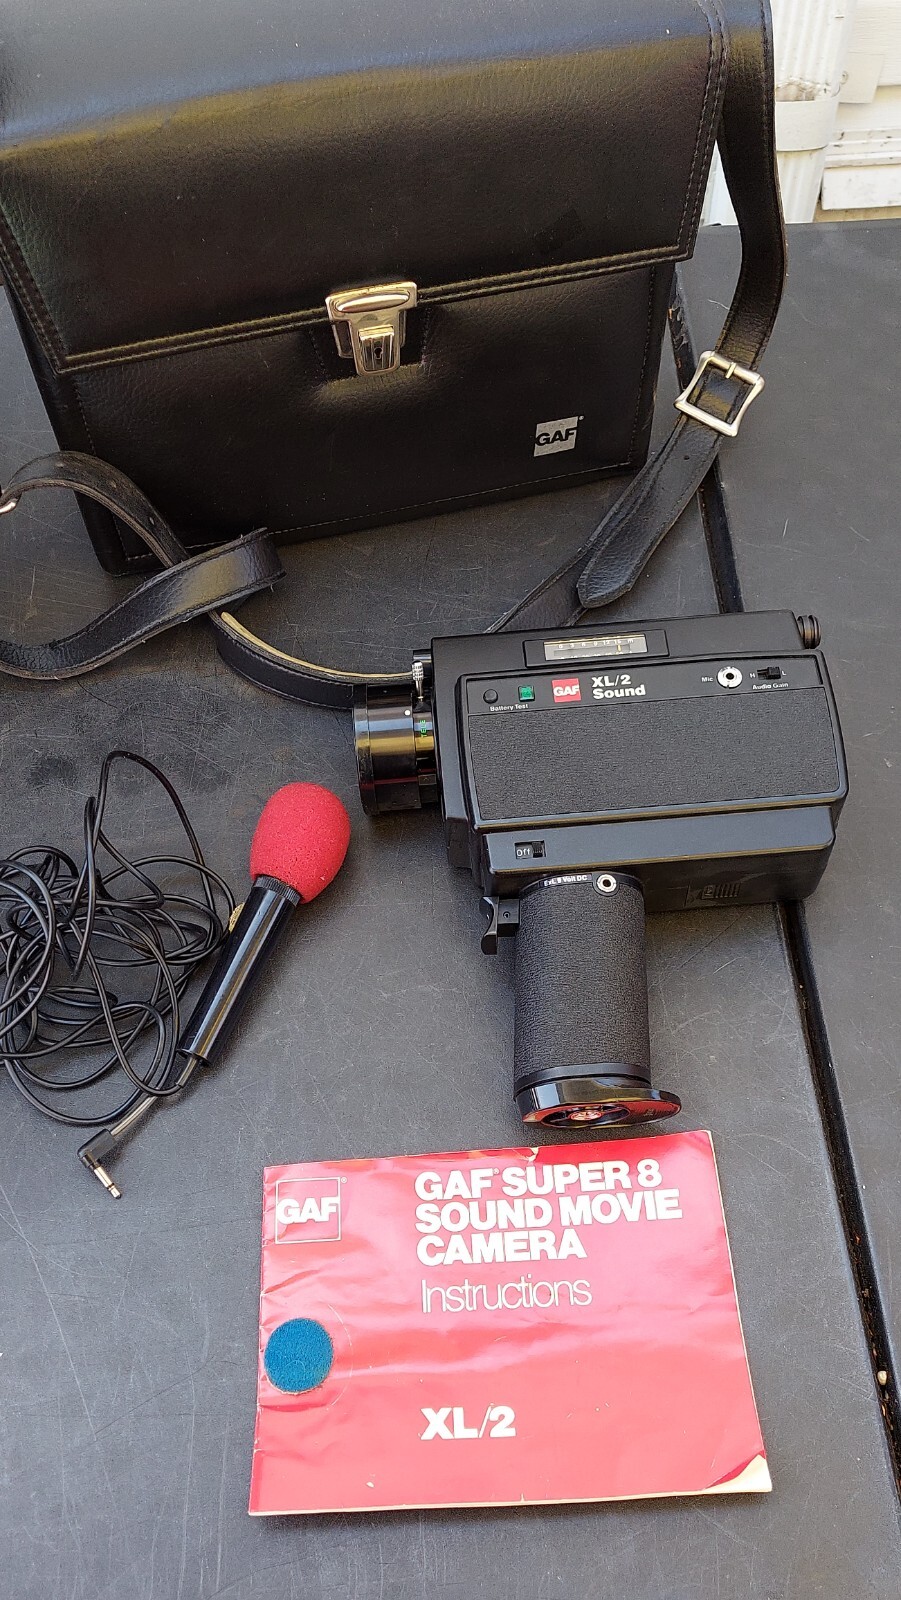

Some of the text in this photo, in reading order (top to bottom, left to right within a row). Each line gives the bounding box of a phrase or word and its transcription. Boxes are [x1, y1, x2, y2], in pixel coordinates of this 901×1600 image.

[535, 427, 577, 446] GAF
[553, 683, 580, 697] GAF
[591, 674, 632, 689] XL/2
[592, 684, 647, 700] Sound
[516, 848, 531, 857] Off
[501, 1160, 632, 1197] SUPER
[636, 1158, 663, 1188] 8
[275, 1196, 340, 1225] GAF
[415, 1188, 683, 1234] SOUND MOVIE
[416, 1228, 588, 1267] CAMERA
[421, 1273, 593, 1314] Instructions
[420, 1404, 517, 1440] XL/2
